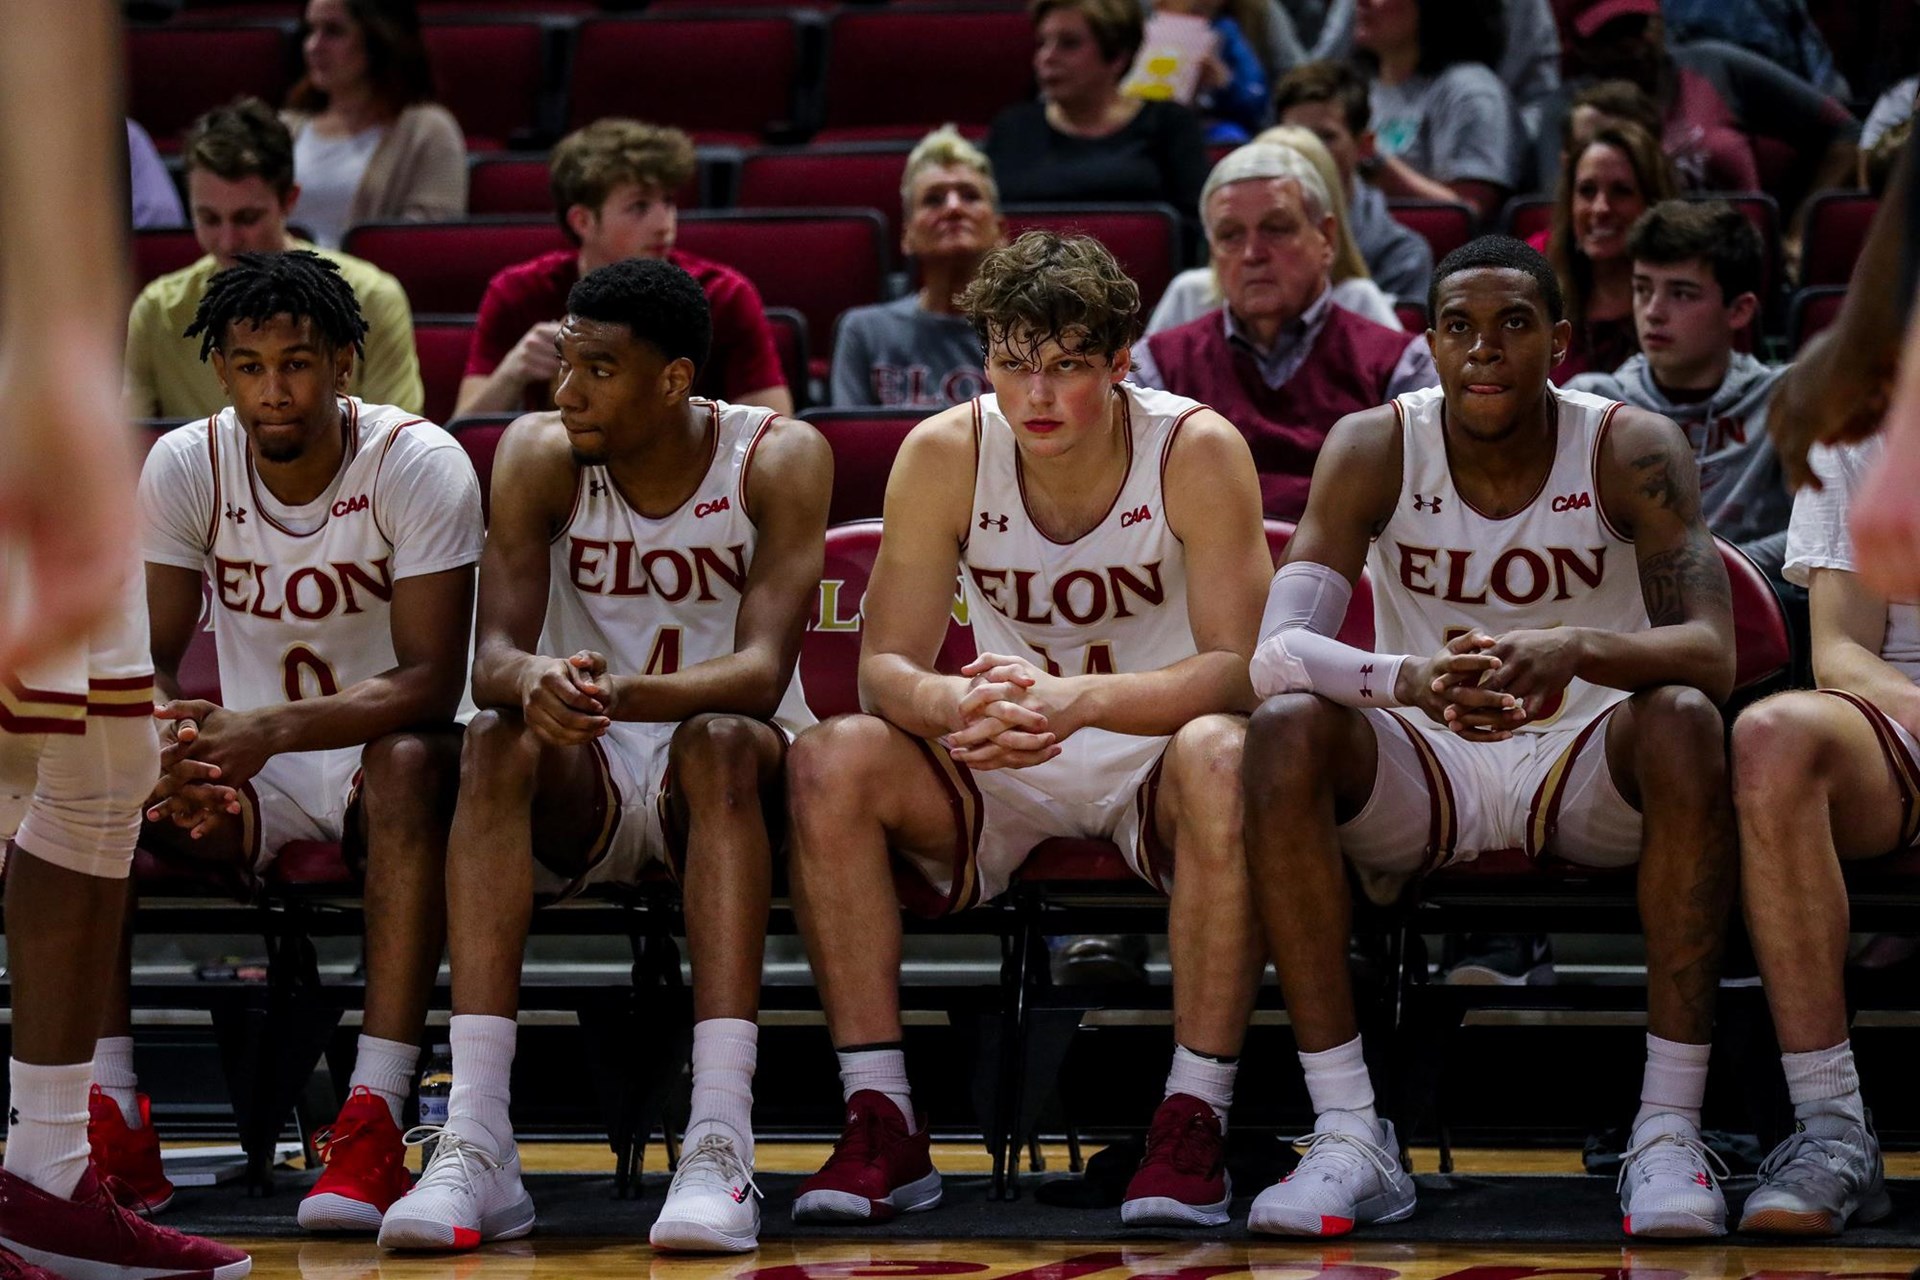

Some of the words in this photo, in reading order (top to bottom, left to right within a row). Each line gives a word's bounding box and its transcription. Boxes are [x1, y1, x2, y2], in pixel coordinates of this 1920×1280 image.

[871, 364, 989, 406] ELO
[331, 494, 370, 518] CAA
[694, 496, 731, 519] CAA
[1120, 504, 1153, 528] CAA
[1551, 492, 1592, 513] CAA
[214, 555, 393, 620] ELON
[569, 536, 747, 602] ELON
[1396, 541, 1607, 605] ELON
[968, 560, 1166, 627] ELON
